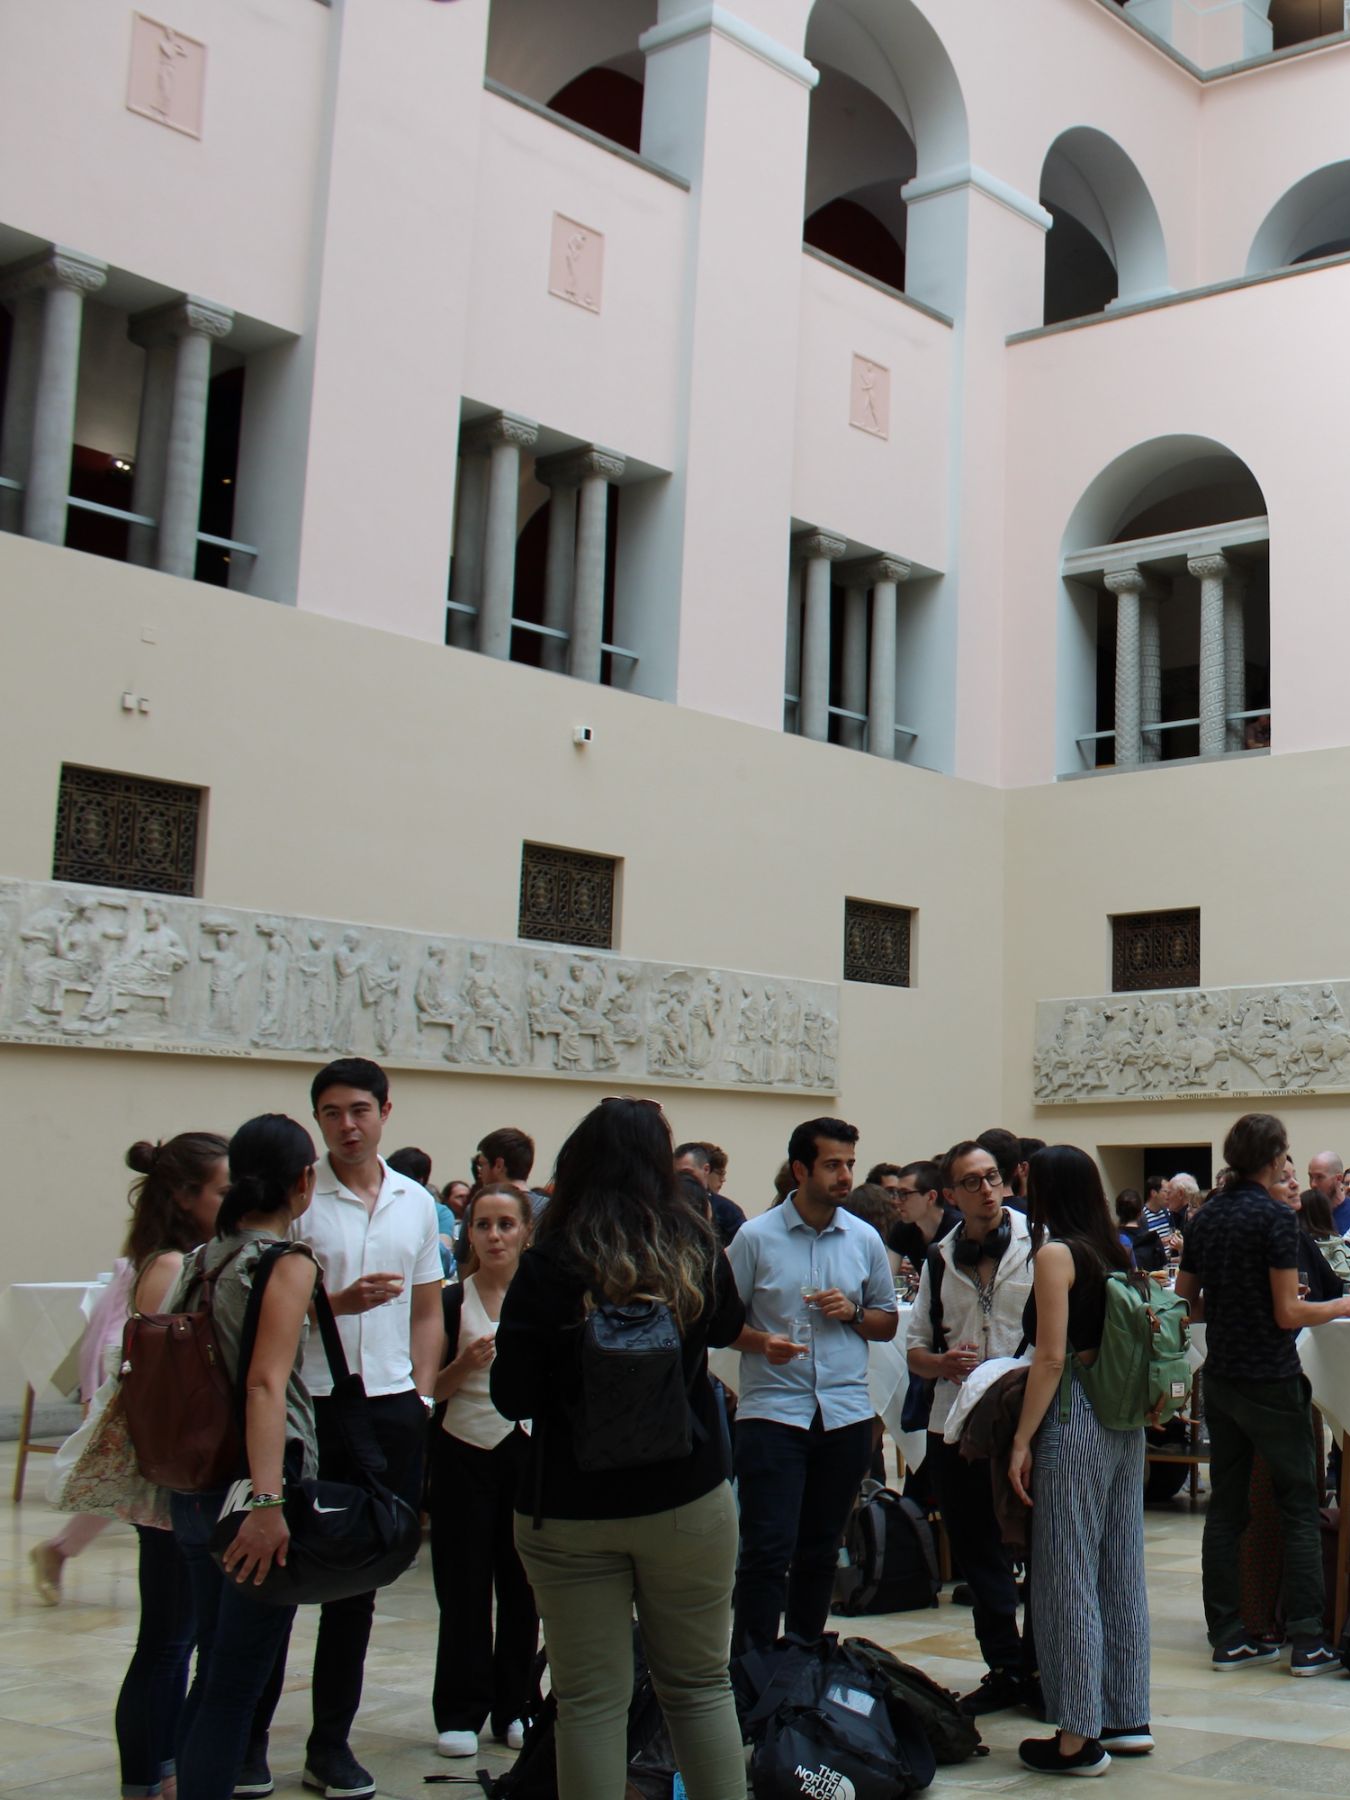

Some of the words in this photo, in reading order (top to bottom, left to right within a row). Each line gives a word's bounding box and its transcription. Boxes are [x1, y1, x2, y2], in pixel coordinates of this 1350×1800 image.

[103, 1040, 134, 1049] DES
[152, 1042, 252, 1056] PARTHENONS
[1262, 1087, 1316, 1097] PARTHENONS
[794, 1764, 838, 1794] NORTH
[818, 1764, 842, 1785] THE
[800, 1781, 833, 1800] FACE
